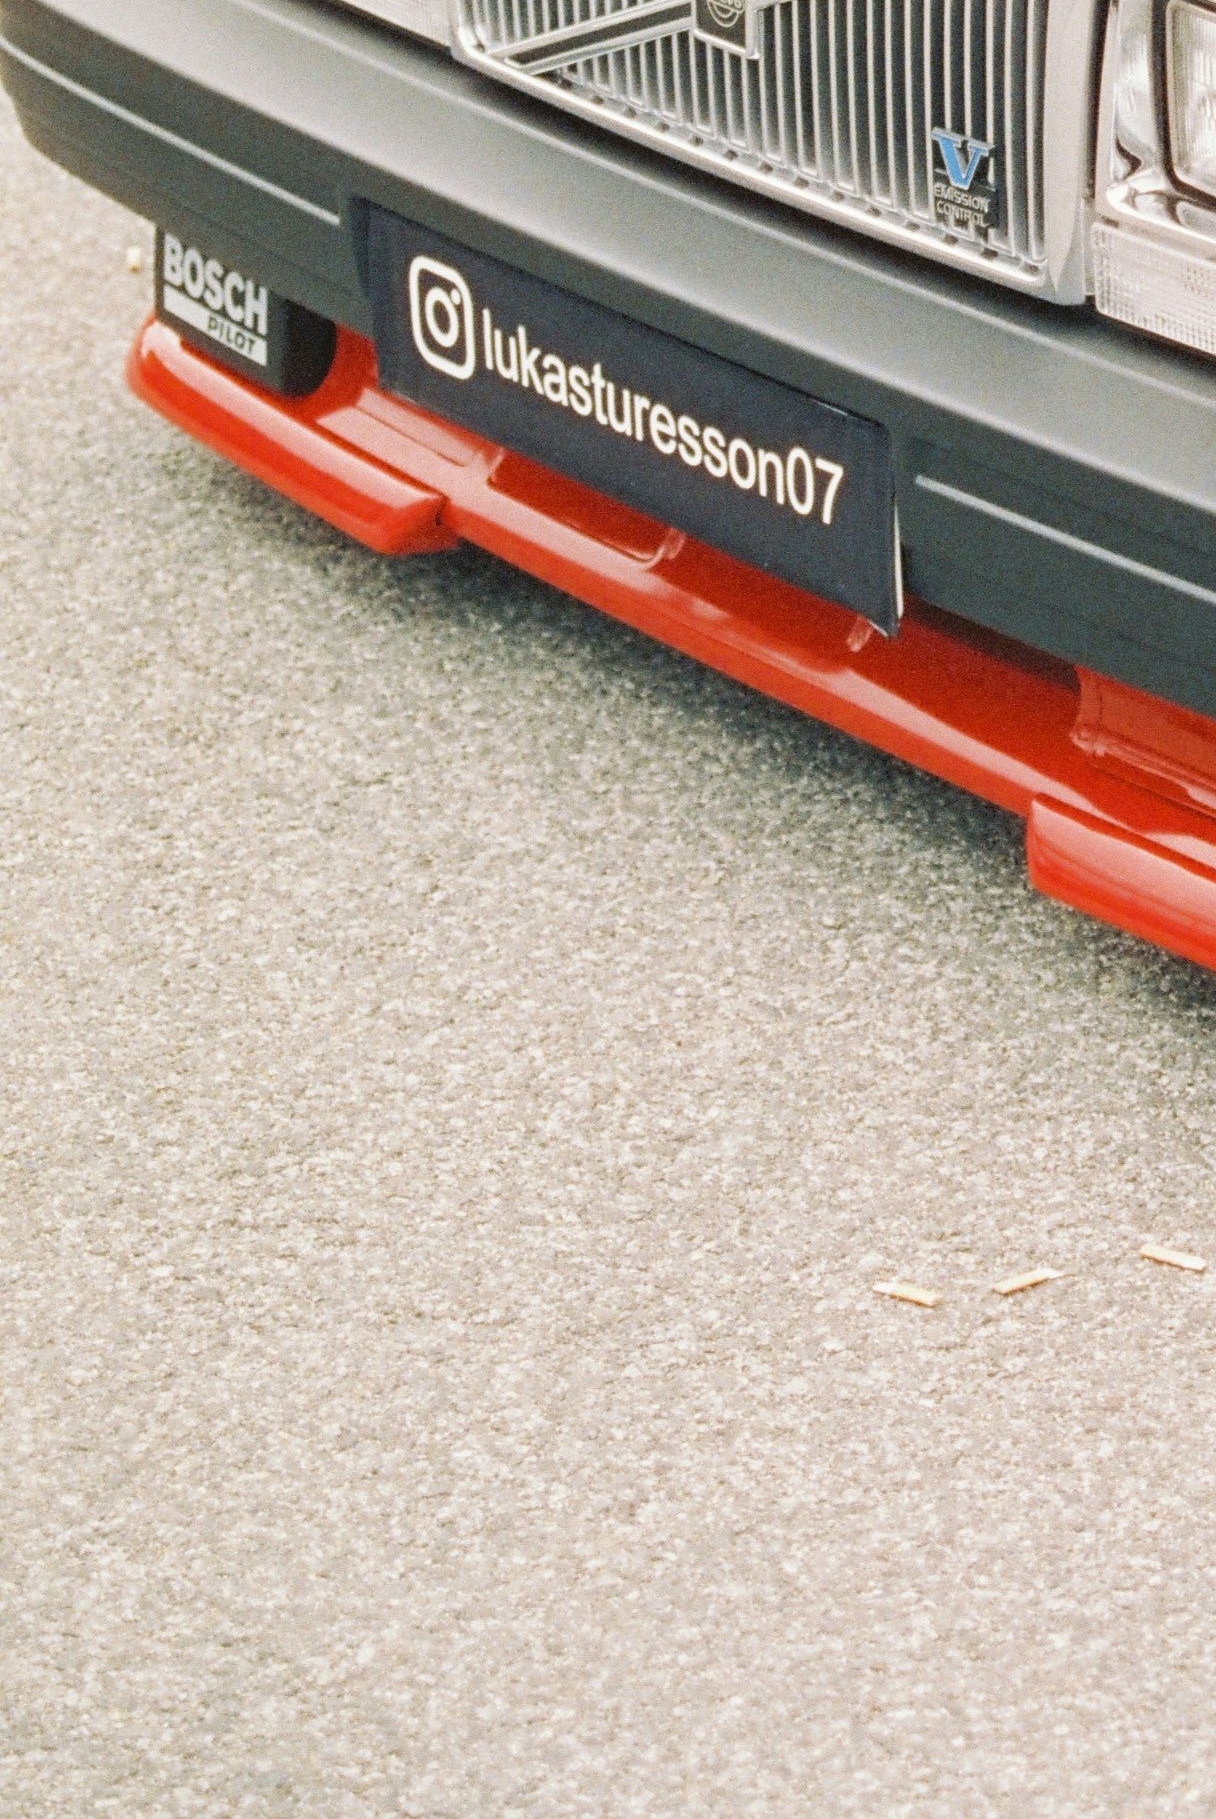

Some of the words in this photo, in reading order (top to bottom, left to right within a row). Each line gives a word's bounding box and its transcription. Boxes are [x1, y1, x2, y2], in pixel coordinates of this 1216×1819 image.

[932, 127, 993, 191] V
[933, 182, 991, 214] EMISSION
[936, 200, 989, 228] CONTROL
[163, 232, 269, 336] BOSCH
[207, 314, 257, 352] PILOT
[481, 308, 845, 524] lukasturesson07
